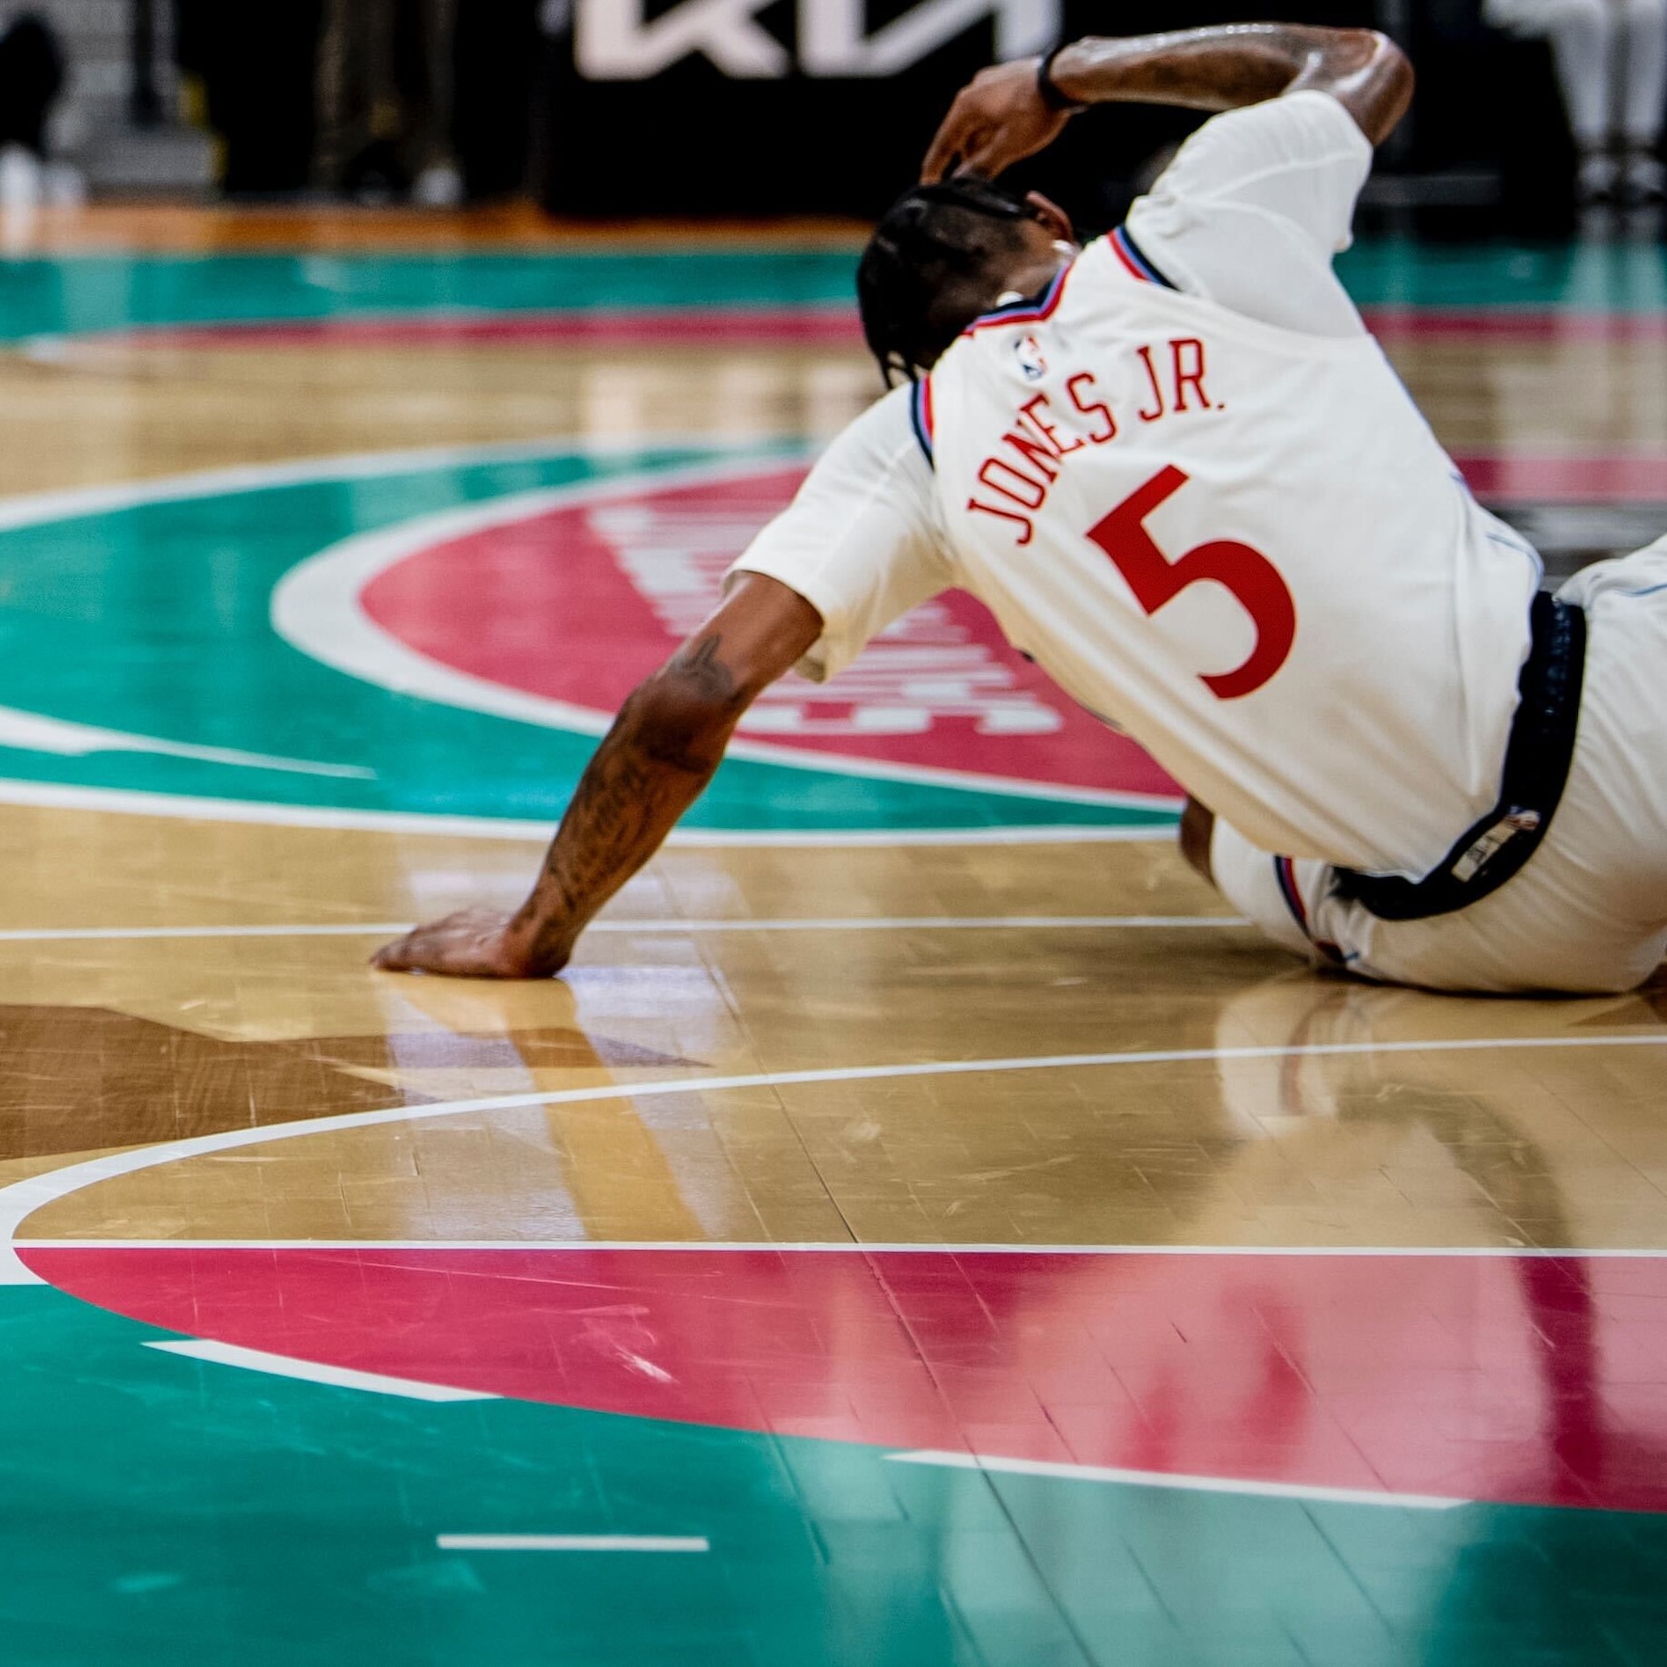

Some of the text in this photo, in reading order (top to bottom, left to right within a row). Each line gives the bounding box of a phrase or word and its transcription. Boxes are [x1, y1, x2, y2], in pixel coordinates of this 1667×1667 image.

[967, 338, 1226, 546] JONES JR.
[1085, 463, 1297, 701] 5
